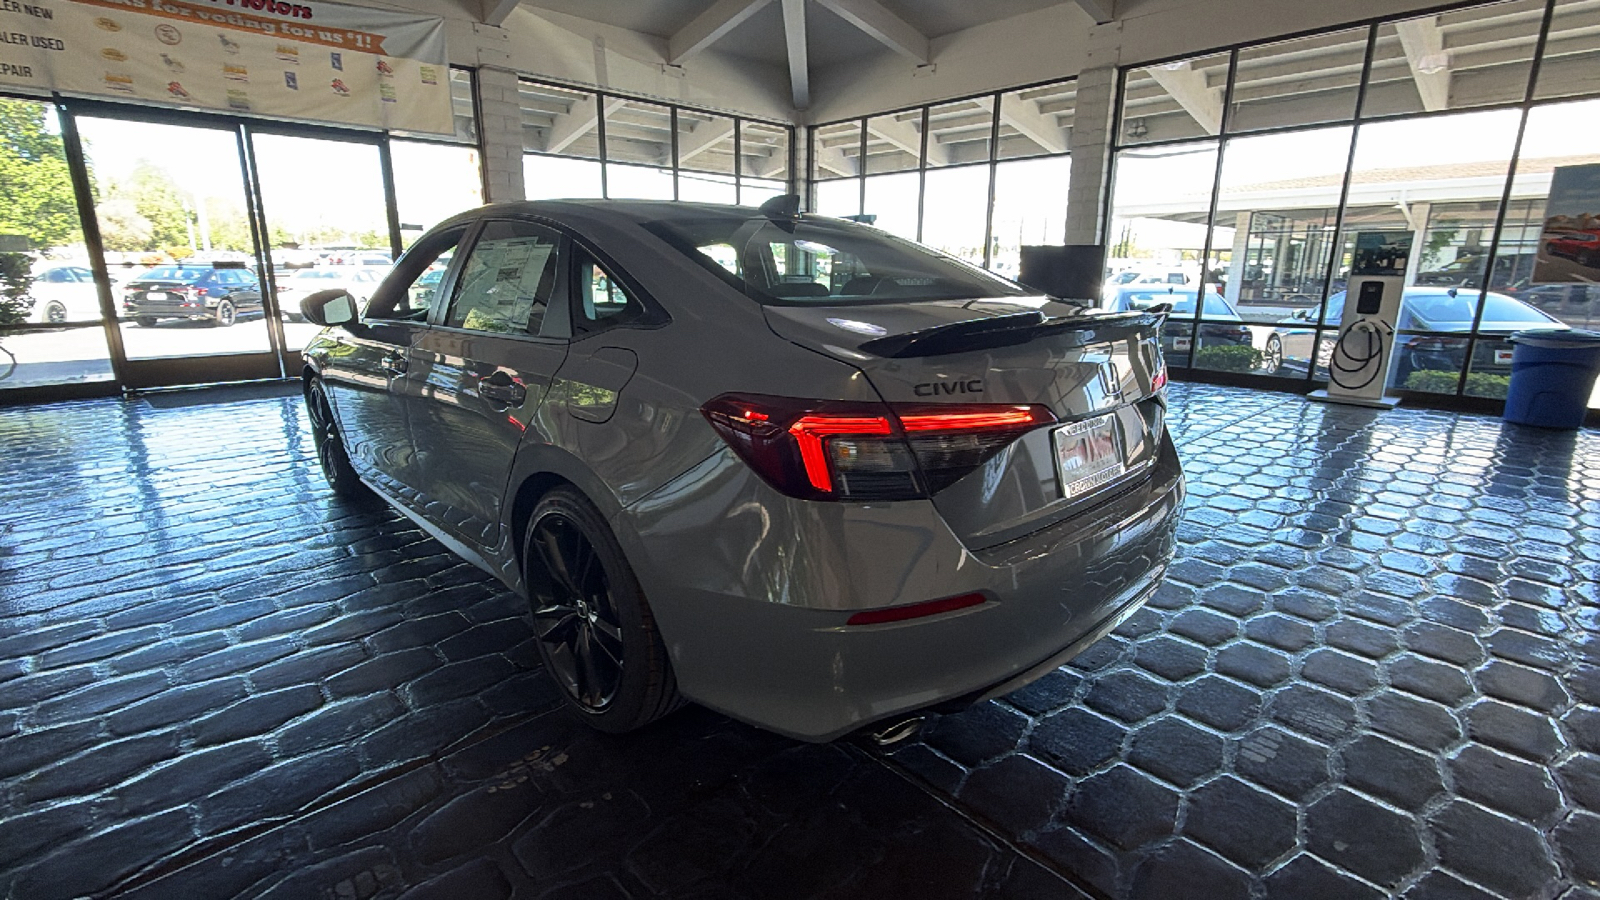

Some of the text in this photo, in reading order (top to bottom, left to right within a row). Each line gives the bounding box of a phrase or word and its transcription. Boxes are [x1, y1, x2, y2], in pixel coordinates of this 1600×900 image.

[24, 4, 53, 20] NEW
[196, 11, 276, 33] voting
[281, 22, 313, 38] for
[318, 31, 343, 43] us
[30, 35, 64, 51] USED
[913, 379, 983, 397] CIVIC
